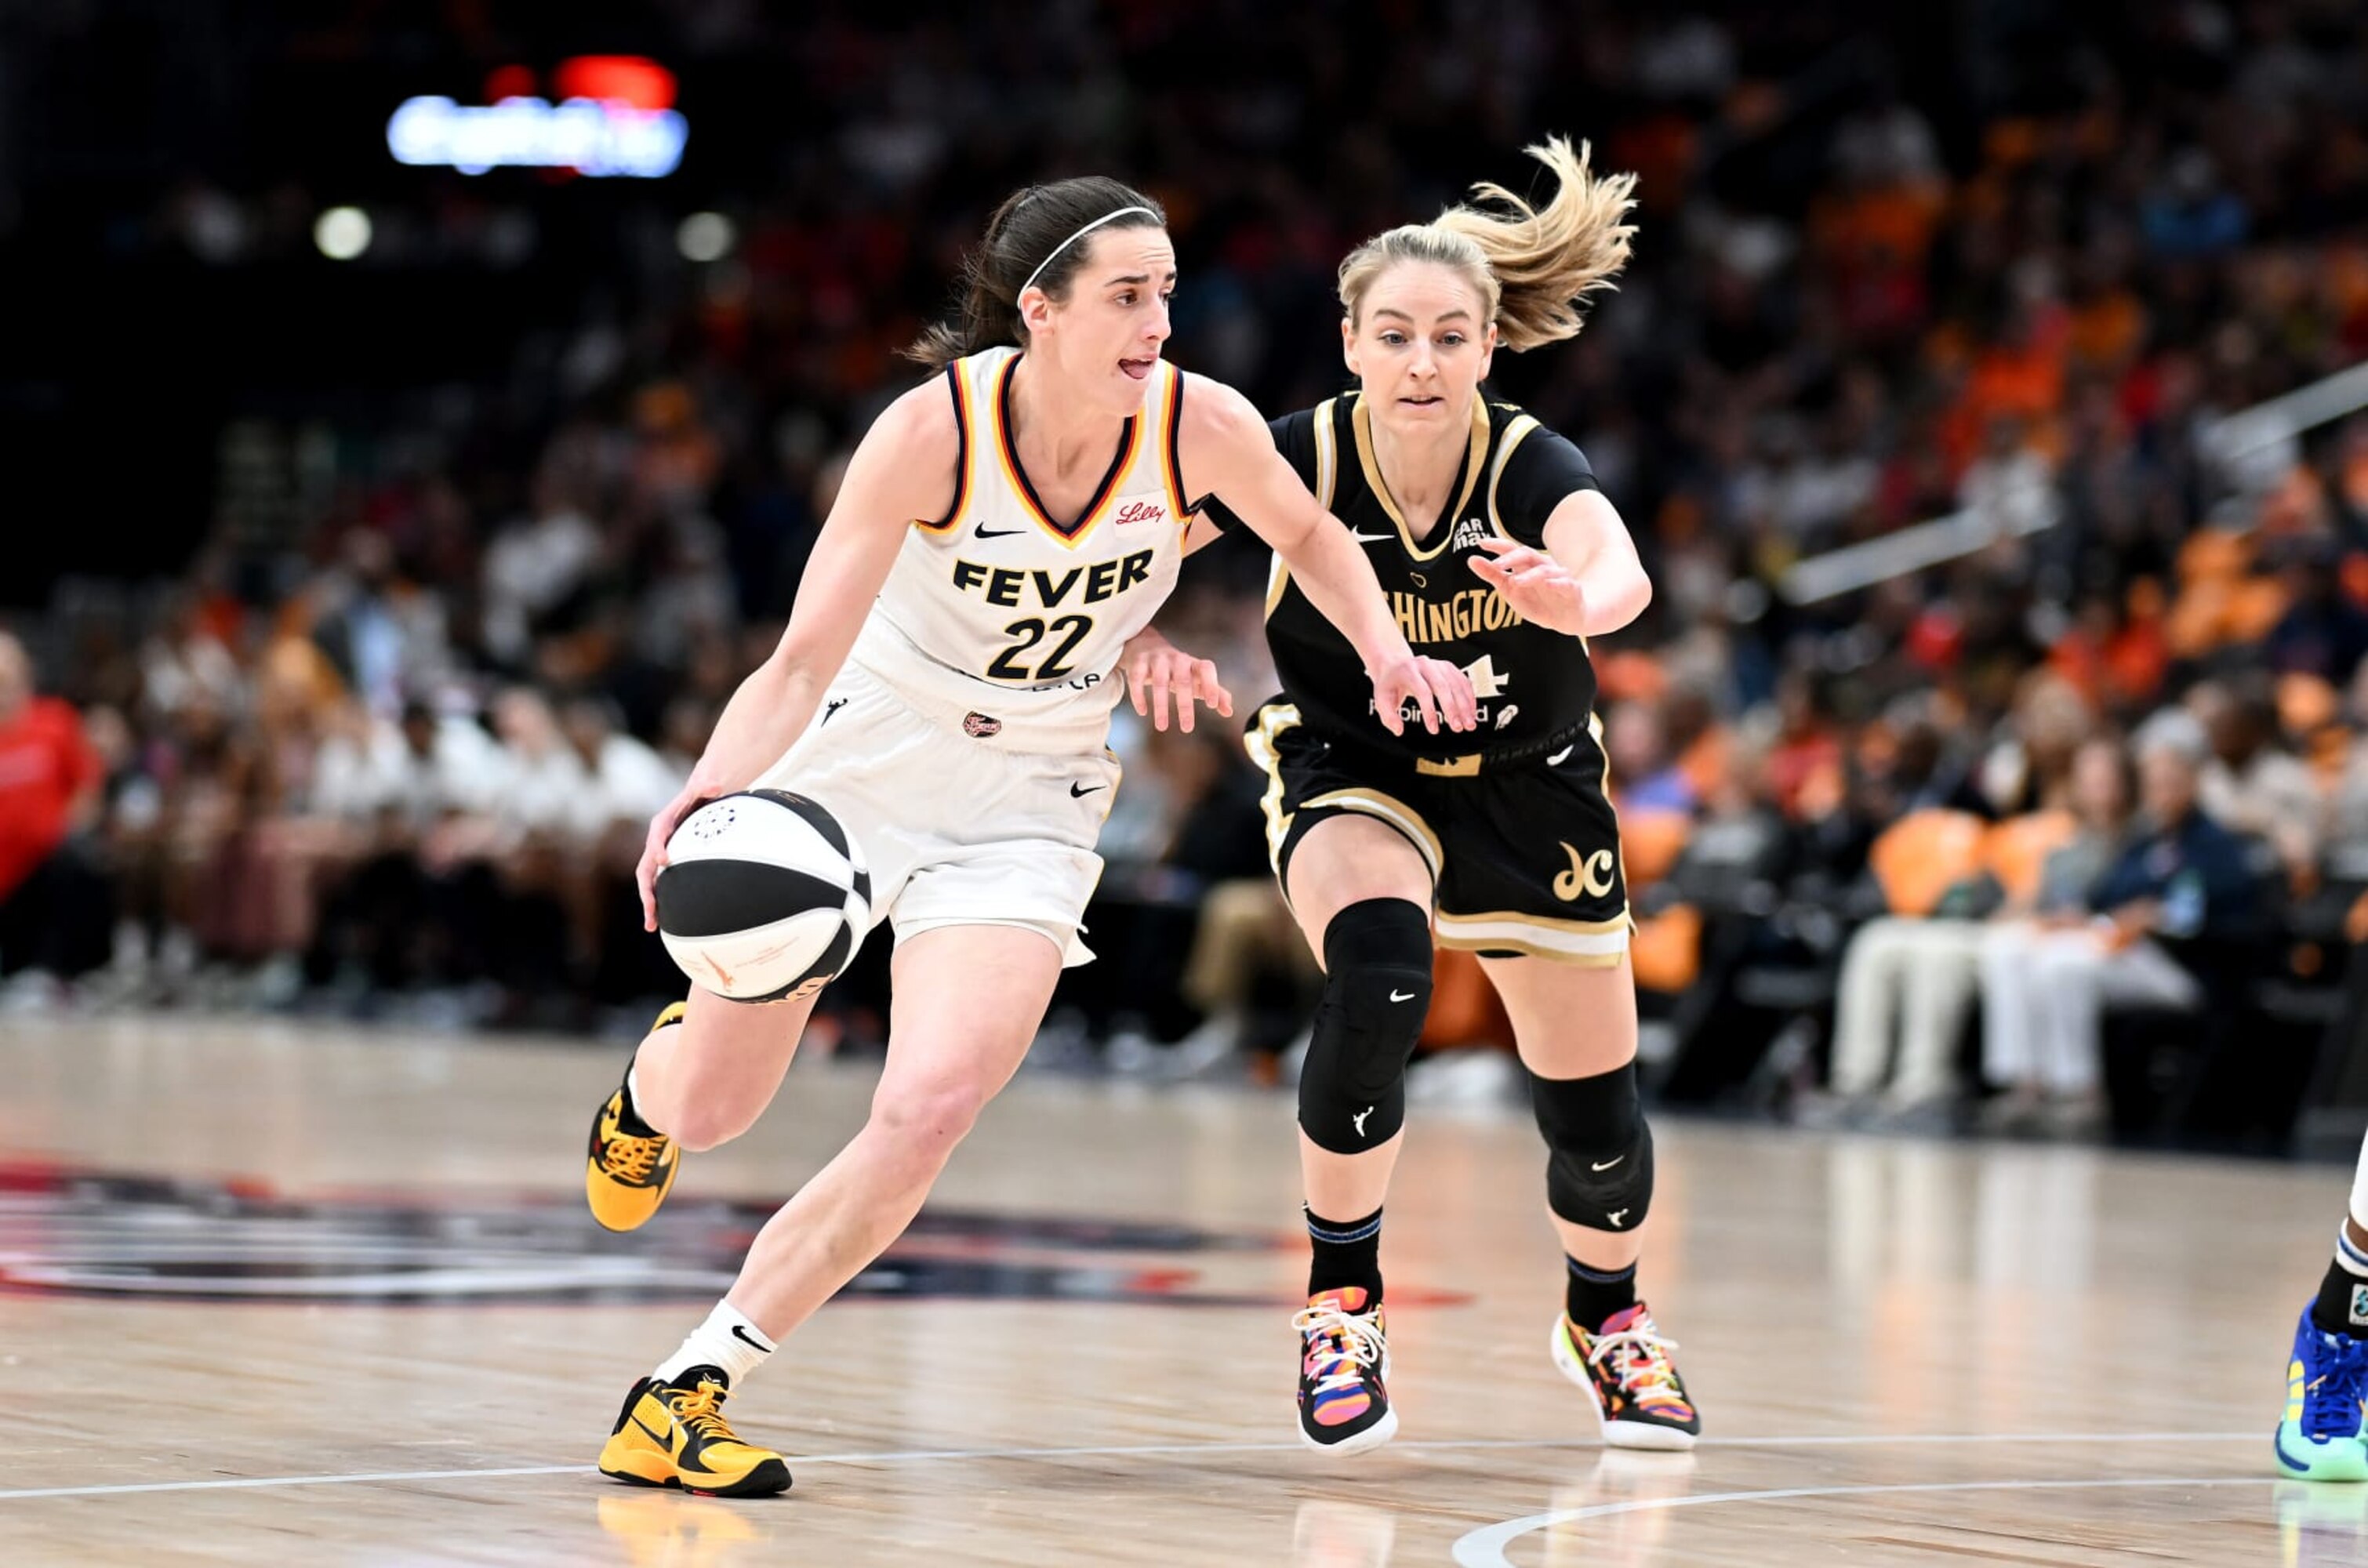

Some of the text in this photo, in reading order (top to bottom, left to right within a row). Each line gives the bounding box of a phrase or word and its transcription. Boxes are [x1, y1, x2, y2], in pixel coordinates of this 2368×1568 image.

[1116, 502, 1165, 524] Lilly
[1455, 517, 1484, 535] AR
[952, 548, 1154, 609] FEVER
[1382, 589, 1524, 643] HINGTO
[986, 614, 1095, 681] 22
